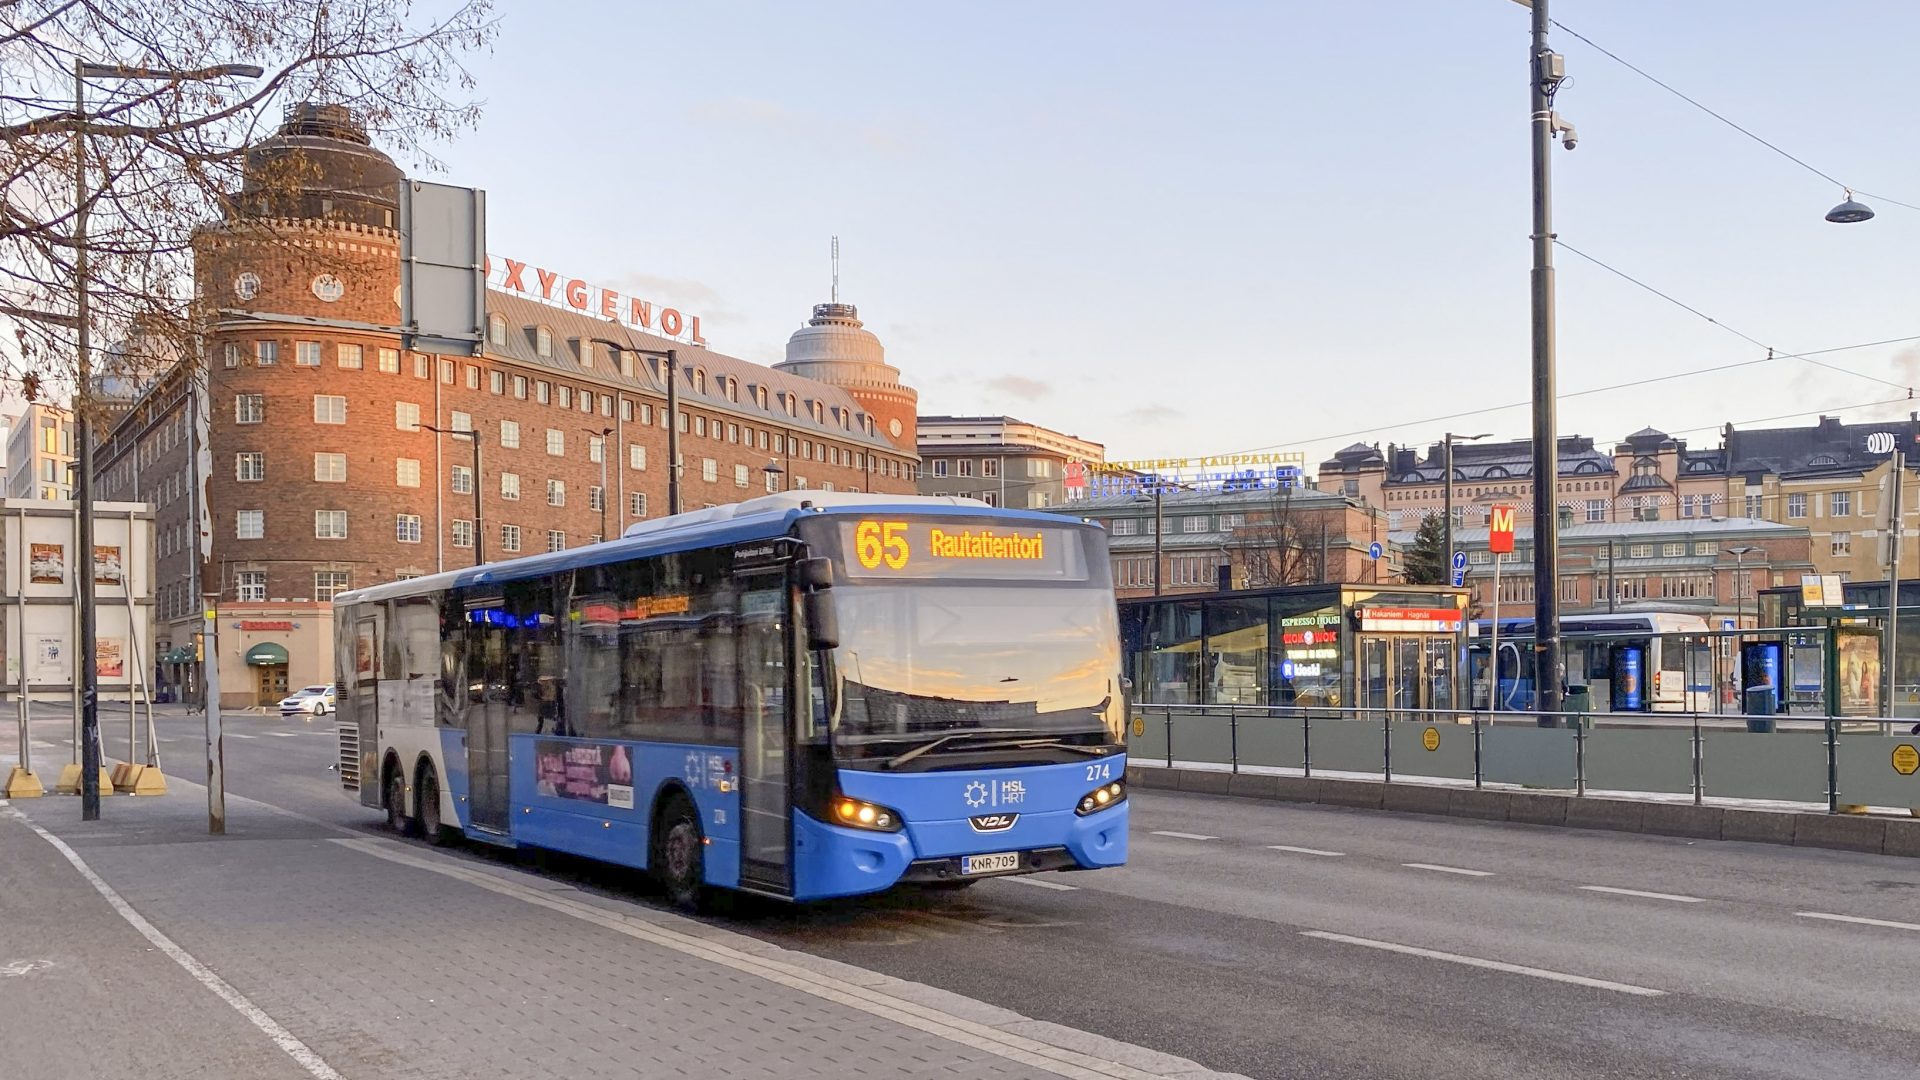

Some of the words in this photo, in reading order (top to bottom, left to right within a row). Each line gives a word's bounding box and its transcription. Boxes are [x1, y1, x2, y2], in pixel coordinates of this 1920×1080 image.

[485, 254, 706, 344] XYGENOL
[1091, 459, 1188, 472] HAKANIEMEN
[1493, 508, 1514, 532] M
[856, 520, 910, 569] 65
[931, 529, 1043, 559] Rautatientori
[1371, 610, 1404, 618] Hakaniemi
[1282, 617, 1316, 627] ESPRESSO
[1315, 631, 1337, 643] WOK
[1294, 663, 1320, 676] kioski
[1086, 764, 1110, 781] 274
[1002, 780, 1027, 792] HSL
[1002, 792, 1027, 804] HRT
[976, 816, 1010, 828] VDL
[971, 856, 1016, 871] KNR-709
